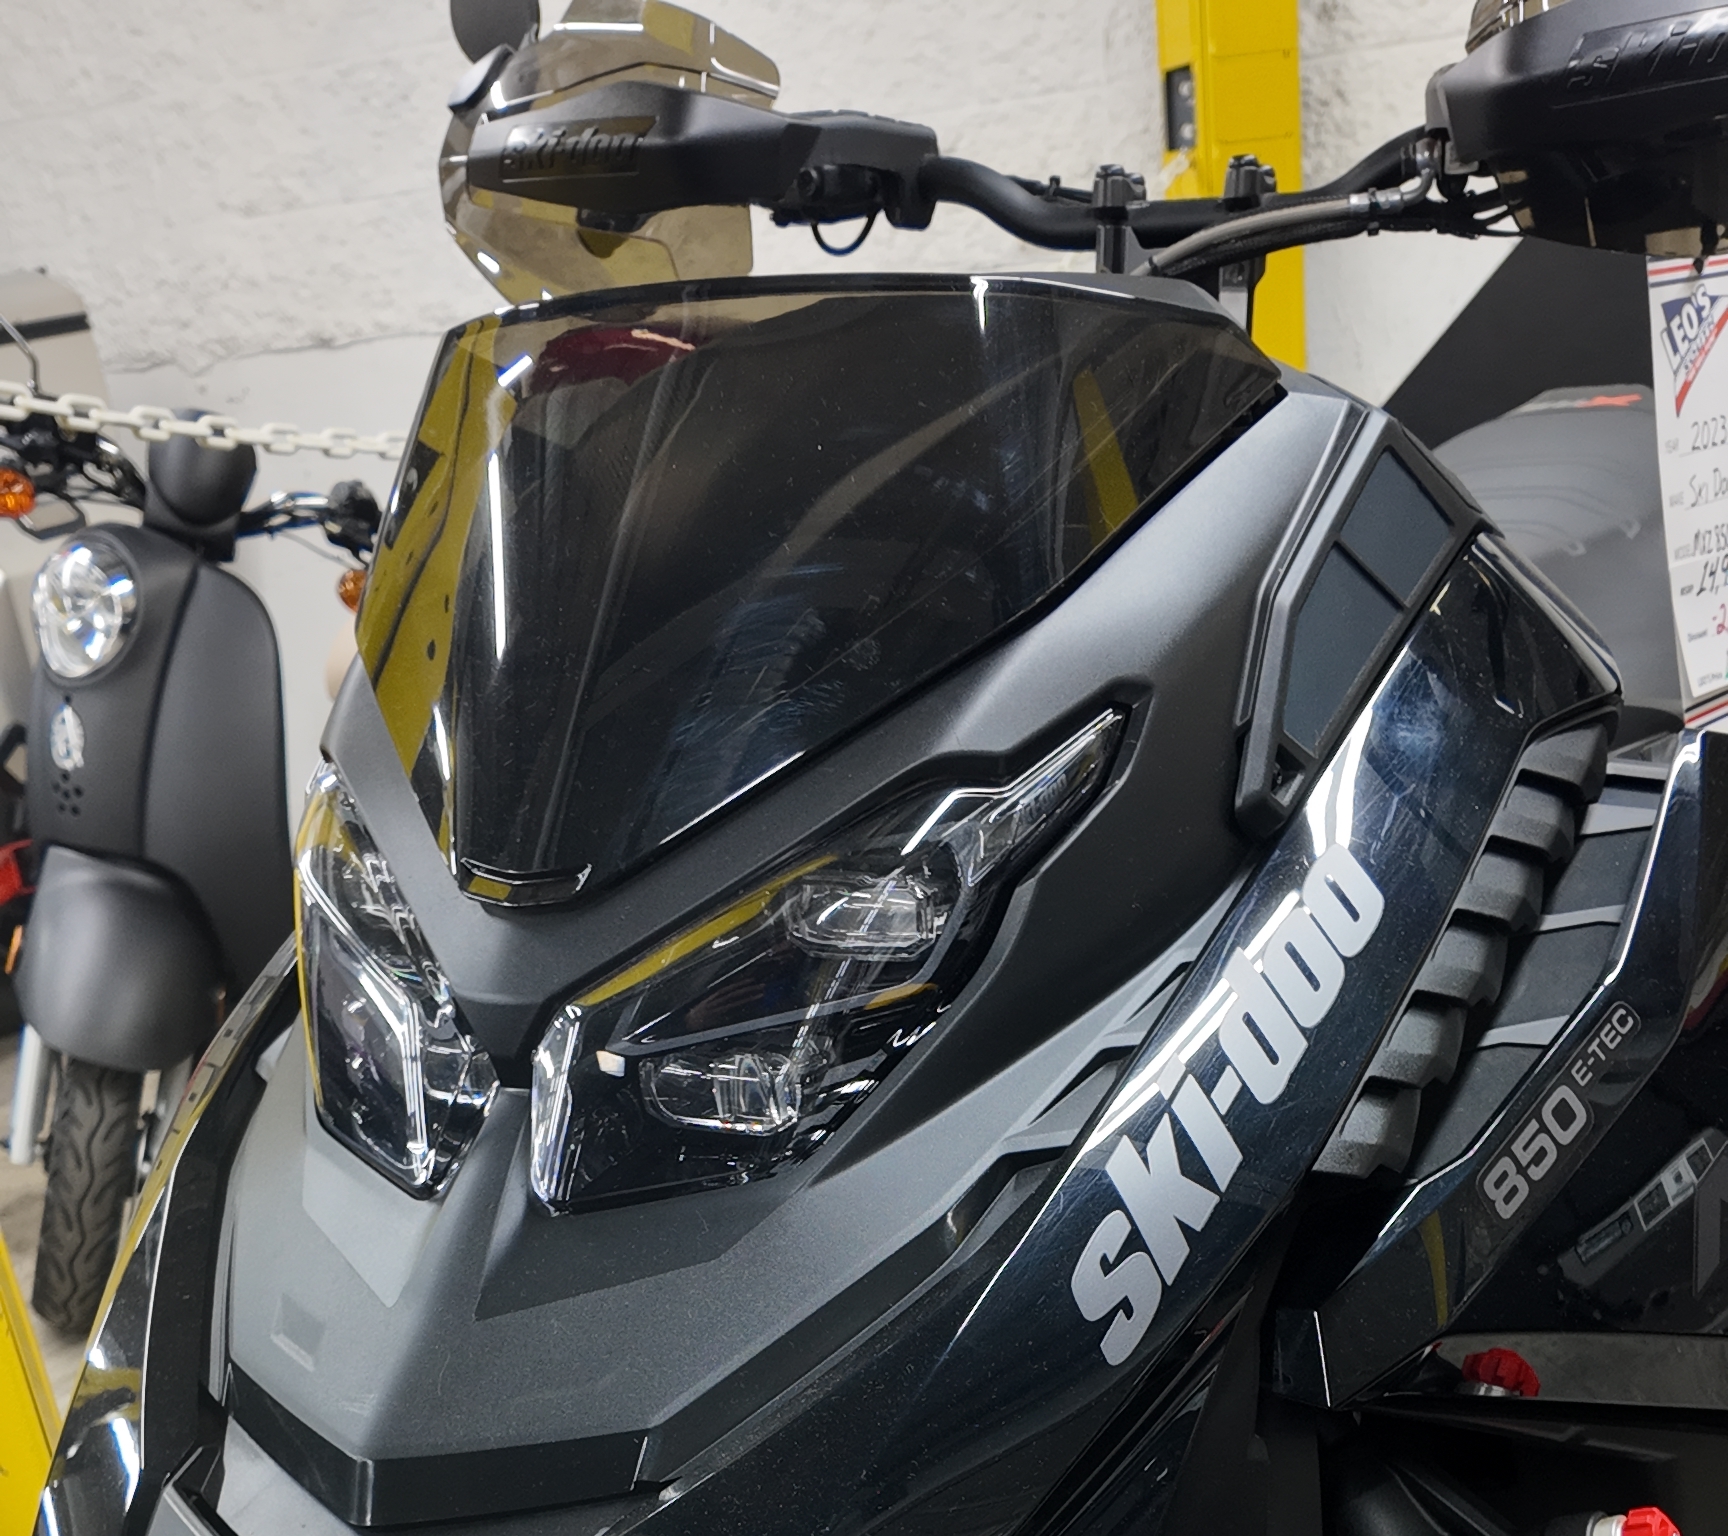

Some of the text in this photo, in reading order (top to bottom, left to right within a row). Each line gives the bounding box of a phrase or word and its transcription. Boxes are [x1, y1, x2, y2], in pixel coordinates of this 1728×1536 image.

[1660, 283, 1712, 375] LEO'S
[1691, 415, 1728, 451] 2023
[1483, 1007, 1634, 1220] 850 E-TEC
